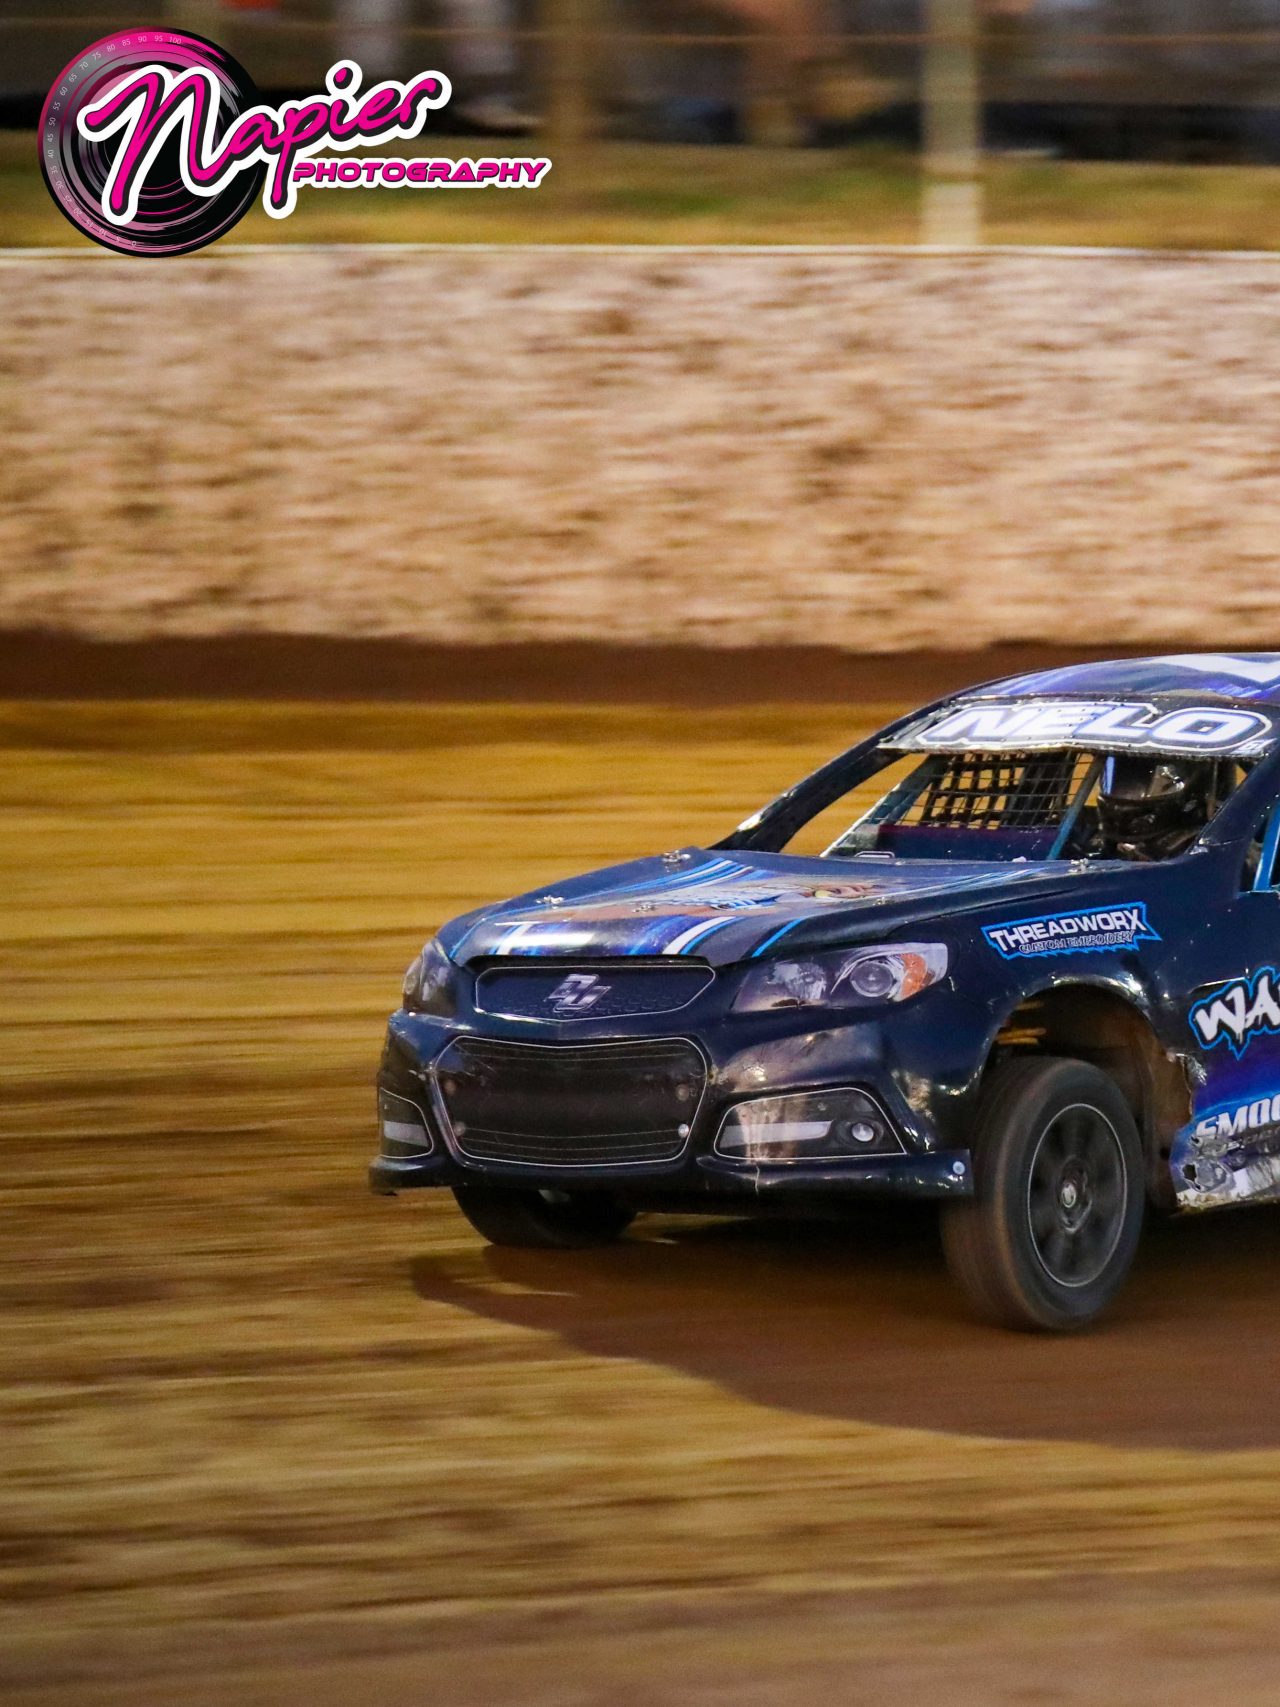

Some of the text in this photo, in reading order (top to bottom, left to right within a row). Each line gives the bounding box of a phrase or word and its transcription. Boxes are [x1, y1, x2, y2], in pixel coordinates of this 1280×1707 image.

[928, 703, 1261, 744] NELO
[988, 908, 1147, 952] THREADWORX
[1018, 929, 1136, 954] CUSTOM EMBROIDERY
